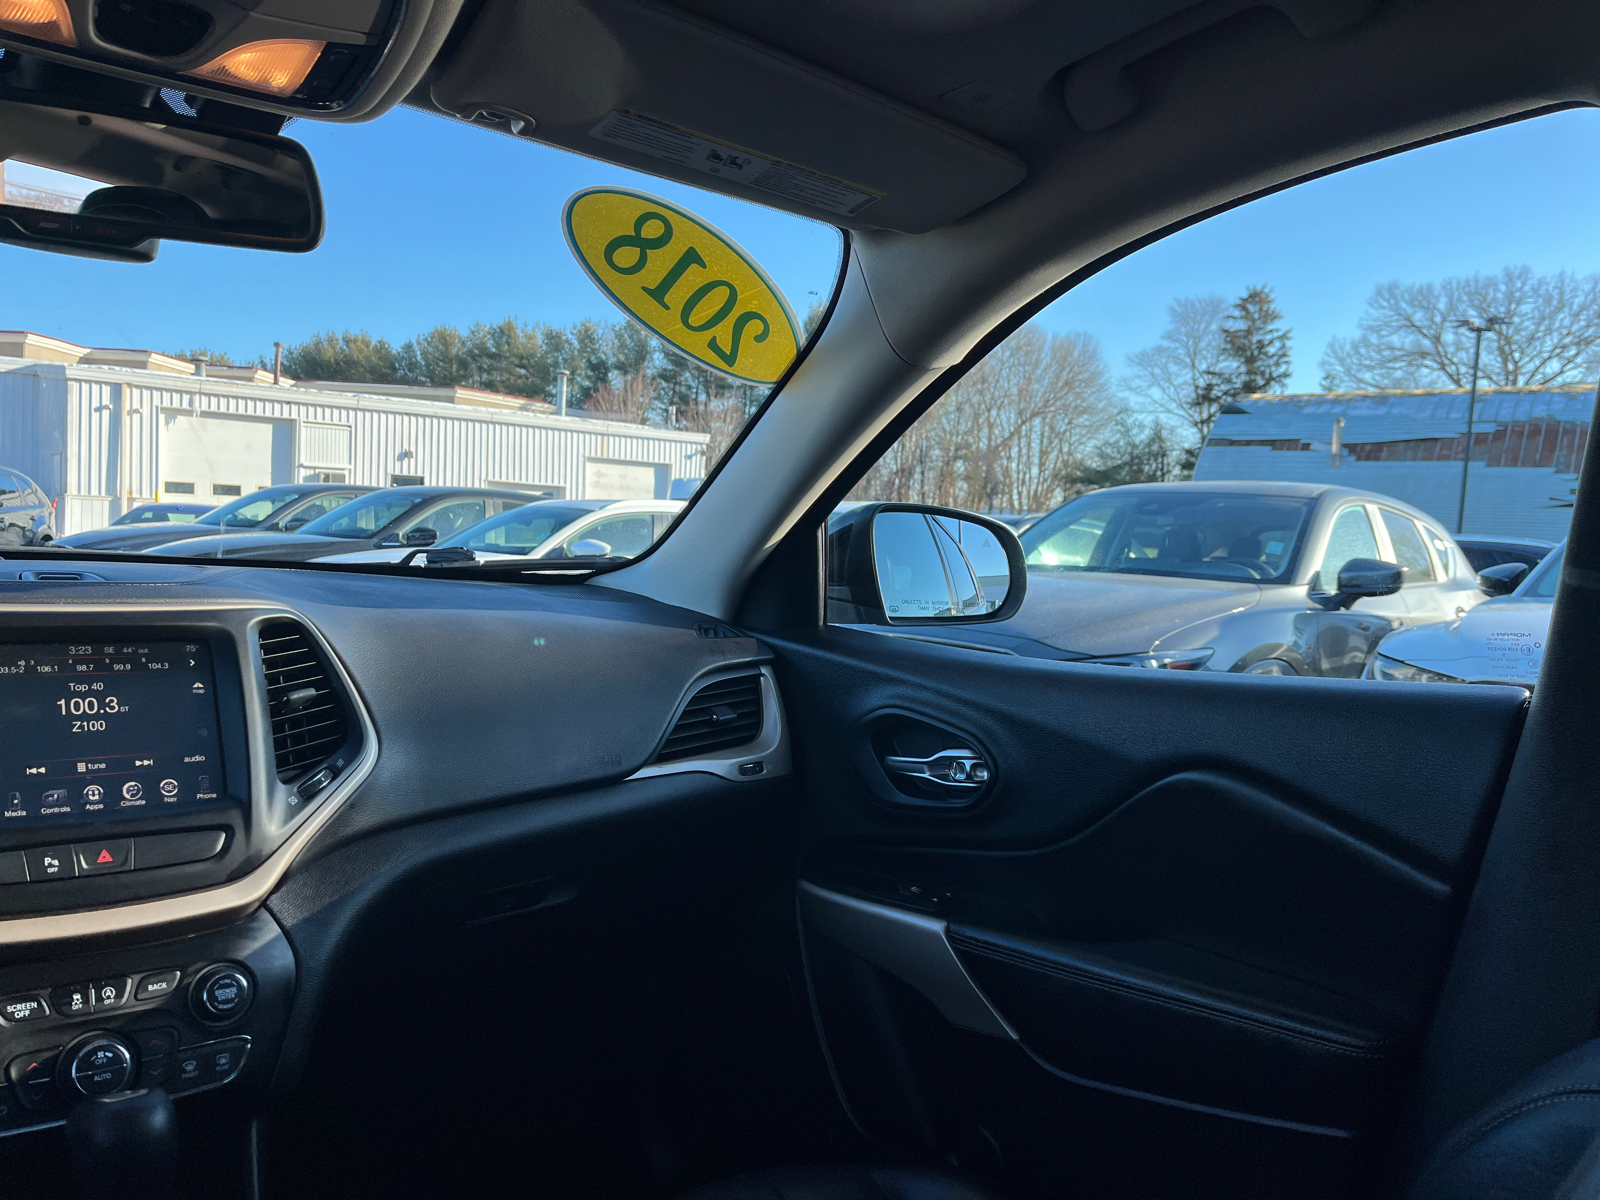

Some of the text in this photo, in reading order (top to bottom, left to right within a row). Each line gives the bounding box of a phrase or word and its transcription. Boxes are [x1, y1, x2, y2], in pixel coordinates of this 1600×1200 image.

[68, 646, 92, 655] 3:23
[103, 646, 115, 654] SE
[36, 665, 58, 673] 106.1
[76, 664, 95, 672] 98.7
[113, 663, 132, 671] 99.9
[148, 662, 169, 670] 104.3
[68, 682, 104, 693] Top 40
[56, 696, 119, 715] 100.3
[72, 720, 106, 732] Z100
[183, 755, 206, 763] audio
[87, 762, 107, 770] tune
[196, 792, 217, 800] Phone
[85, 803, 105, 811] Apps
[120, 799, 147, 807] Climate
[4, 809, 27, 817] Media
[41, 805, 71, 814] Controls
[147, 982, 168, 991] BACK
[6, 1001, 38, 1013] SCREEN
[71, 1002, 83, 1010] OFF
[14, 1009, 31, 1019] OFF
[95, 1056, 107, 1066] OFF
[93, 1072, 112, 1082] AUTO
